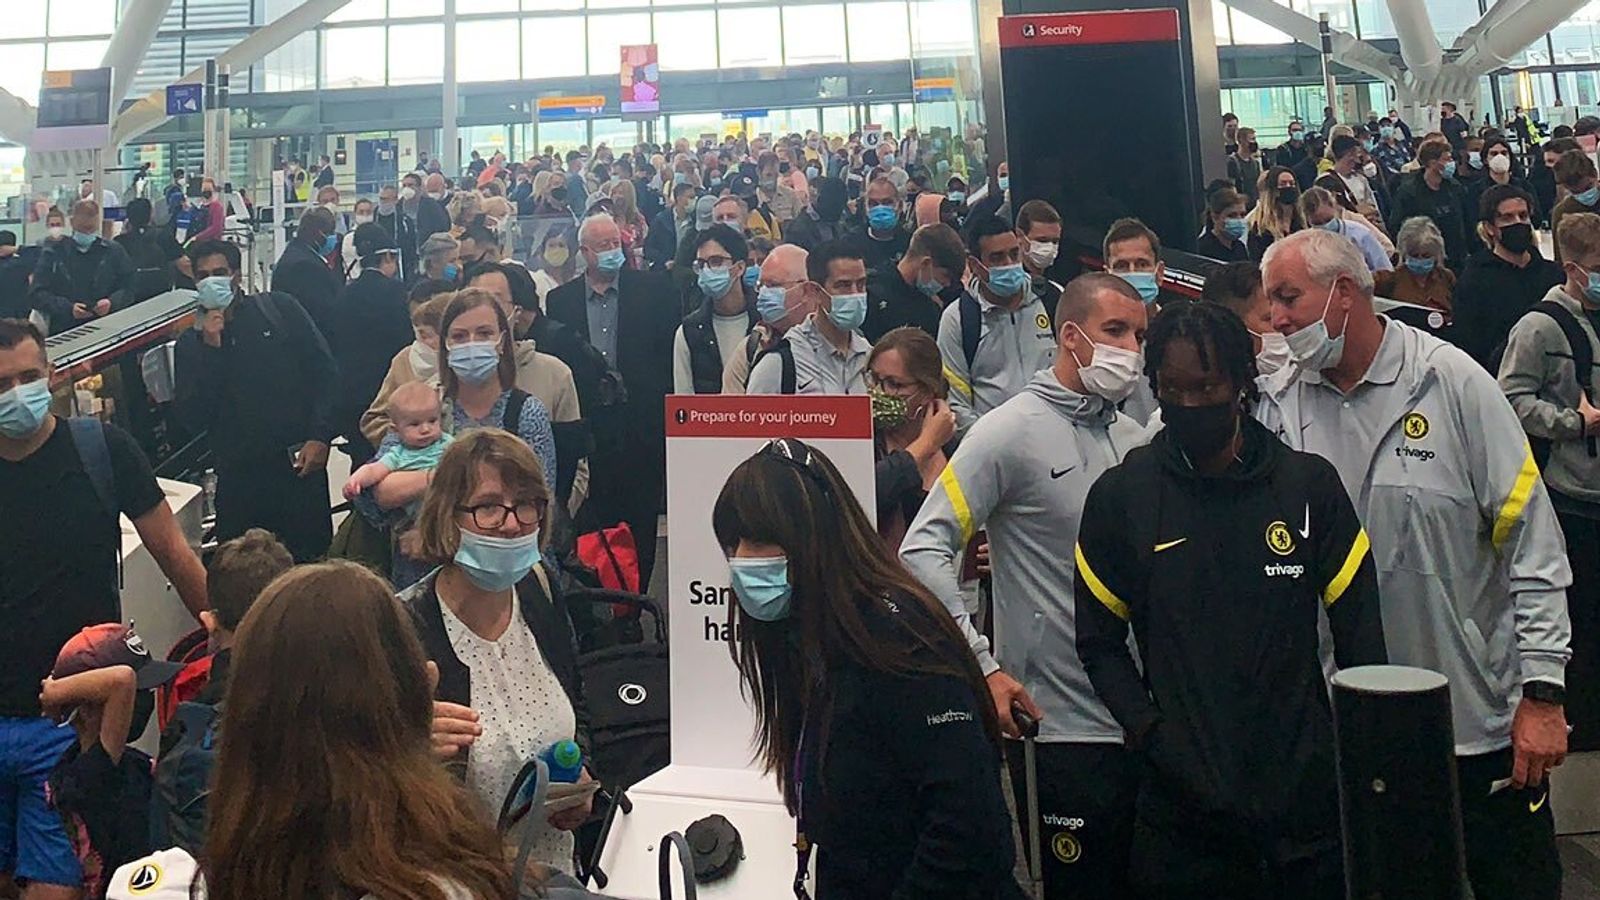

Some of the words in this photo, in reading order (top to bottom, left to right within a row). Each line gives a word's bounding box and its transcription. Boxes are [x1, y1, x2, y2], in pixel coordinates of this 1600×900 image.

[1040, 23, 1083, 37] Security
[690, 409, 736, 424] Prepare
[738, 409, 756, 423] for
[759, 411, 787, 426] your
[789, 409, 838, 426] journey
[1263, 562, 1304, 578] trivago
[704, 615, 742, 642] ha
[926, 708, 973, 726] Heathrow
[1042, 813, 1085, 830] trivago
